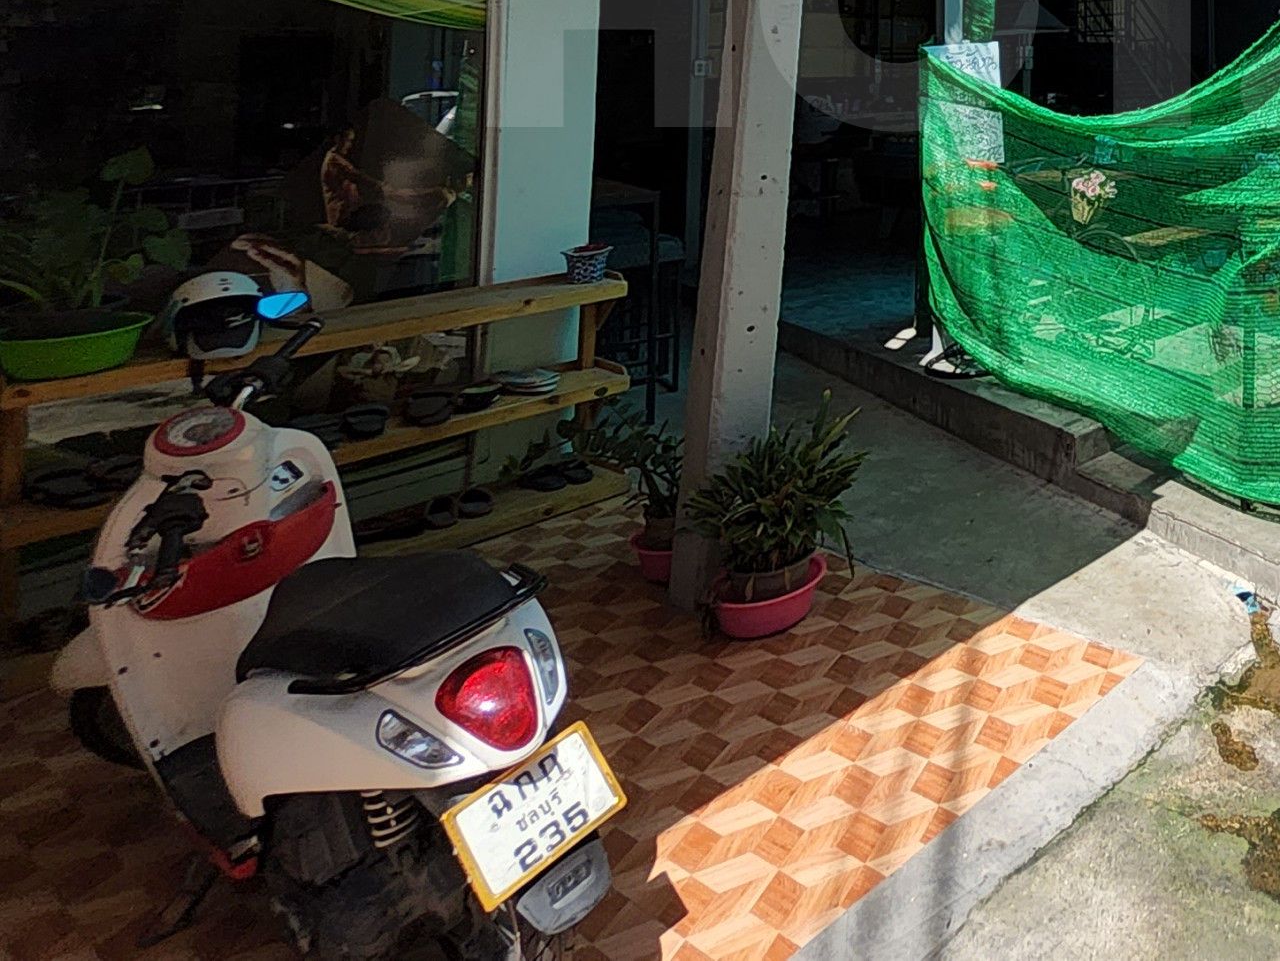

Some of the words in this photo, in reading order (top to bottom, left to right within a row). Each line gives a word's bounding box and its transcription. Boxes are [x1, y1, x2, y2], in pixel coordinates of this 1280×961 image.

[513, 800, 591, 873] 235
[515, 789, 563, 831] ชลบุรี
